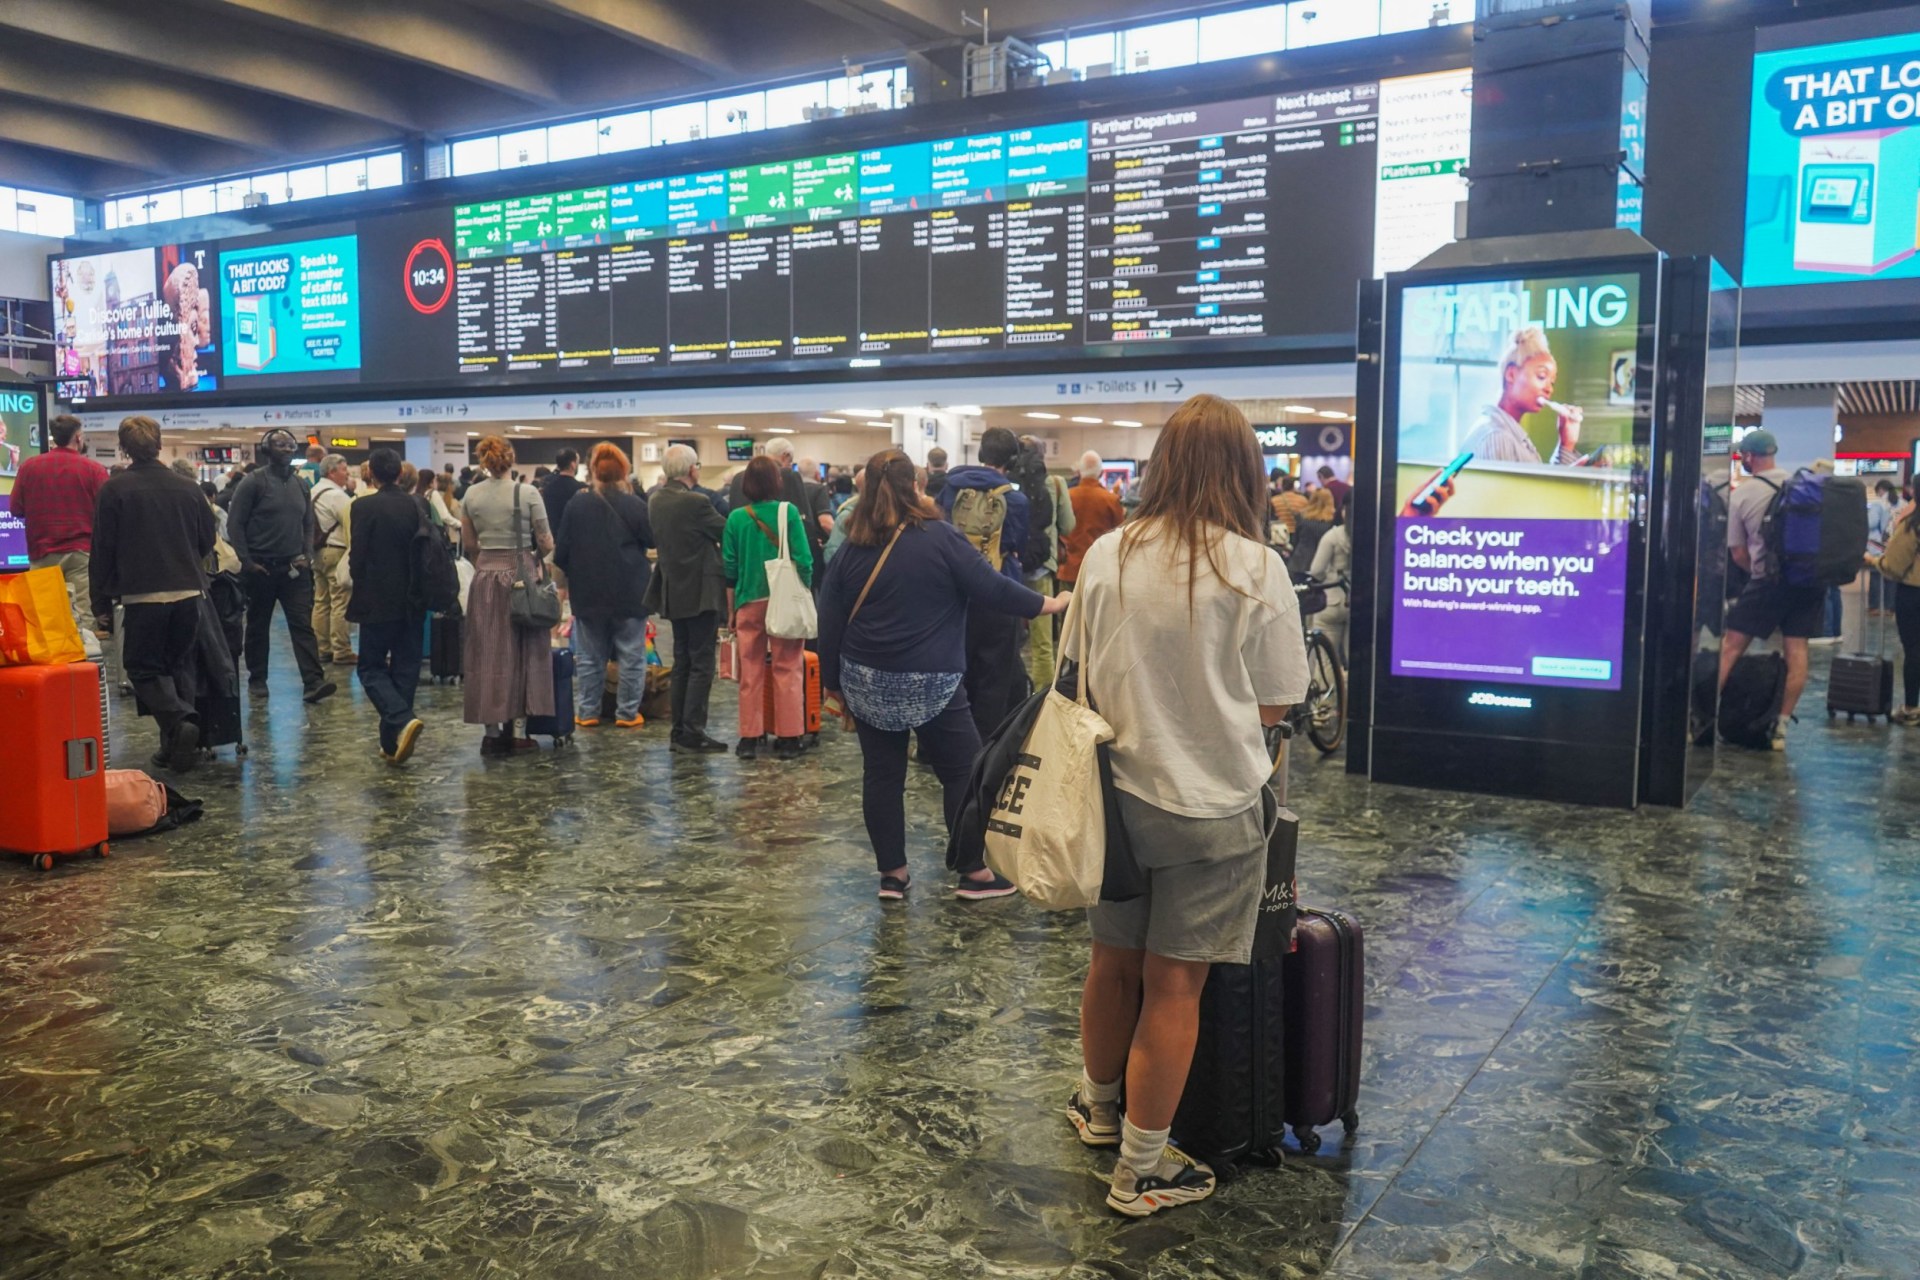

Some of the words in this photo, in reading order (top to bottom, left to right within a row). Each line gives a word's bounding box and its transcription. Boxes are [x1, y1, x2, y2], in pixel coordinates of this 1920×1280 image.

[1783, 66, 1874, 100] THAT
[1276, 95, 1305, 111] Next
[1307, 88, 1351, 106] fastest
[1793, 104, 1819, 130] A
[1826, 97, 1880, 127] BIT
[1092, 120, 1133, 136] Further
[1134, 112, 1197, 130] Departures
[932, 152, 969, 167] Liverpool
[1382, 164, 1431, 178] Platform
[1434, 162, 1442, 173] 9
[194, 250, 206, 270] T
[228, 262, 255, 279] THAT
[255, 258, 290, 276] LOOKS
[300, 254, 327, 270] Speak
[328, 254, 338, 264] to
[301, 272, 307, 281] a
[308, 267, 344, 280] member
[412, 268, 446, 287] 10:34
[232, 282, 241, 294] A
[242, 278, 257, 293] BIT
[258, 275, 287, 291] ODD?
[301, 283, 311, 295] of
[312, 280, 333, 293] staff
[333, 282, 343, 291] or
[302, 297, 320, 308] text
[320, 292, 349, 306] 61016
[1411, 283, 1628, 336] STARLING
[89, 306, 137, 324] Discover
[139, 300, 174, 321] Tullie,
[117, 326, 143, 341] home
[144, 324, 154, 337] of
[155, 322, 188, 337] culture
[1098, 380, 1137, 393] Toilets
[0, 519, 26, 529] eeth.
[1405, 525, 1472, 547] Check
[1474, 528, 1524, 548] your
[1404, 548, 1488, 571] balance
[1490, 552, 1549, 572] when
[1553, 557, 1594, 575] you
[1403, 572, 1463, 593] brush
[1466, 577, 1513, 598] your
[1514, 576, 1580, 598] teeth.
[1266, 902, 1289, 913] FOOD
